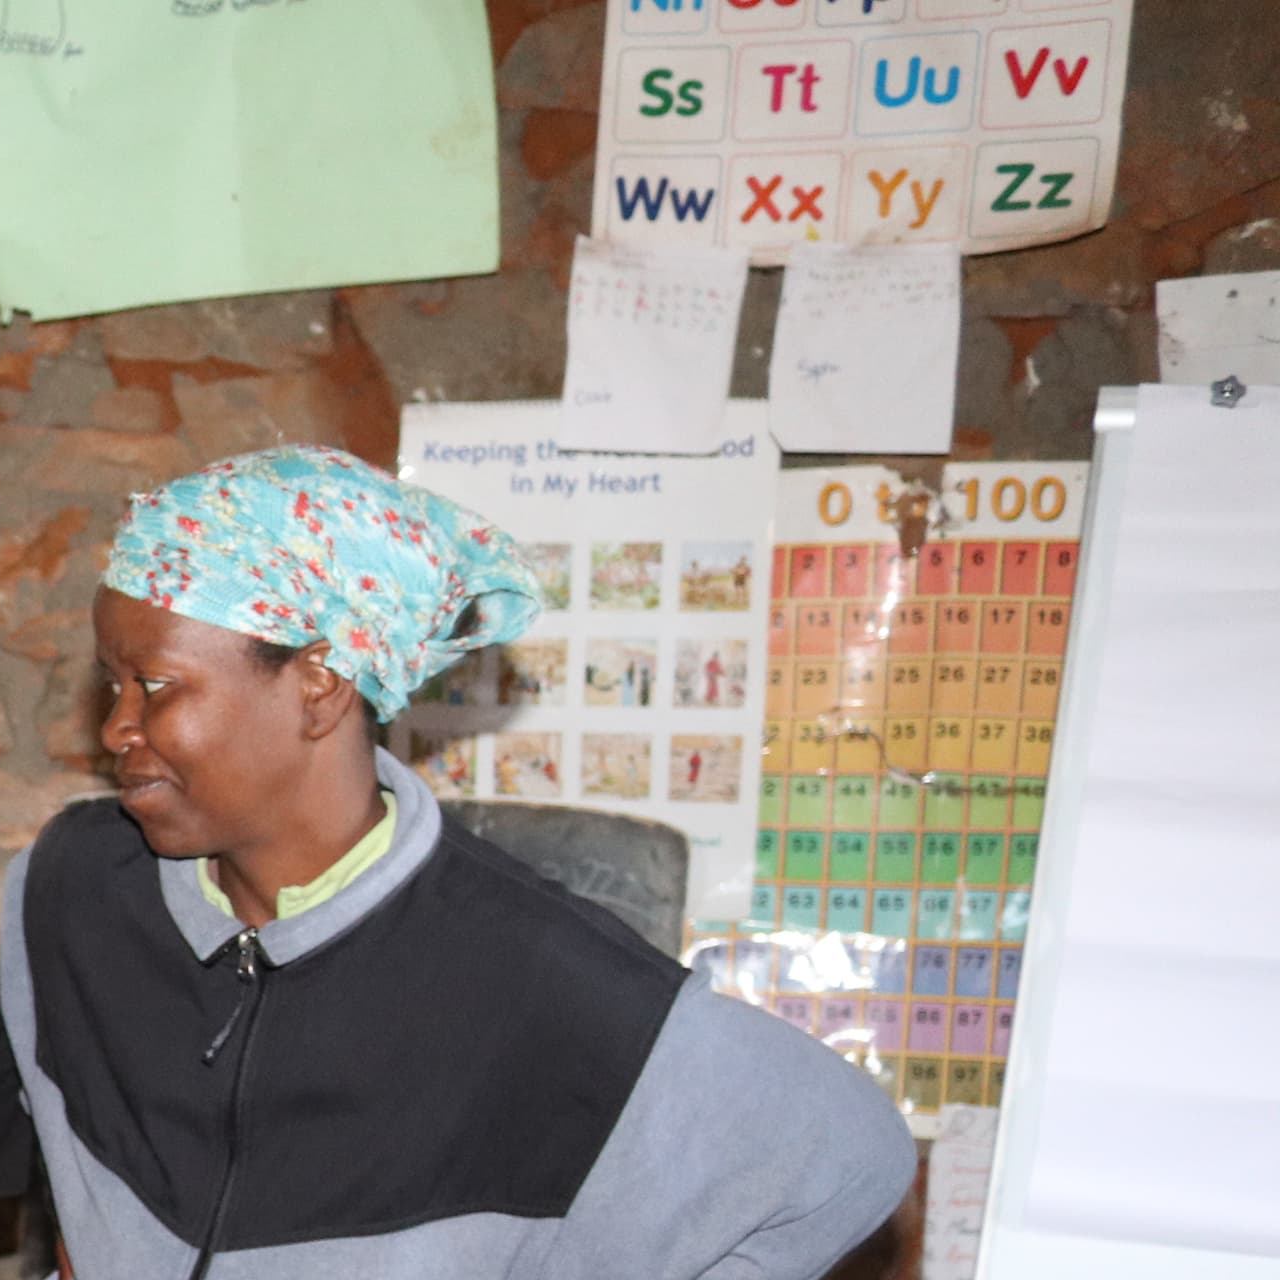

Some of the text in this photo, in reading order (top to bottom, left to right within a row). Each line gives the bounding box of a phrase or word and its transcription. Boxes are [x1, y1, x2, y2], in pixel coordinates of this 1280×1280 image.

[639, 47, 1089, 117] Ss Tt Uu Vv
[616, 163, 1074, 229] Ww Xx Yy Zz
[423, 439, 528, 467] Keeping
[543, 473, 579, 498] My
[588, 470, 661, 493] Heart
[818, 482, 852, 526] 0
[963, 475, 1067, 523] 100
[972, 551, 985, 567] 6
[1015, 550, 1028, 566] 7
[806, 608, 831, 627] 13
[898, 607, 924, 626] 15
[944, 607, 970, 625] 16
[992, 607, 1016, 625] 17
[1037, 608, 1063, 626] 18
[802, 669, 828, 686] 23
[894, 667, 920, 684] 25
[939, 666, 966, 682] 26
[984, 666, 1012, 684] 27
[1030, 668, 1057, 686] 28
[891, 723, 917, 740] 35
[935, 722, 961, 739] 36
[979, 722, 1006, 740] 37
